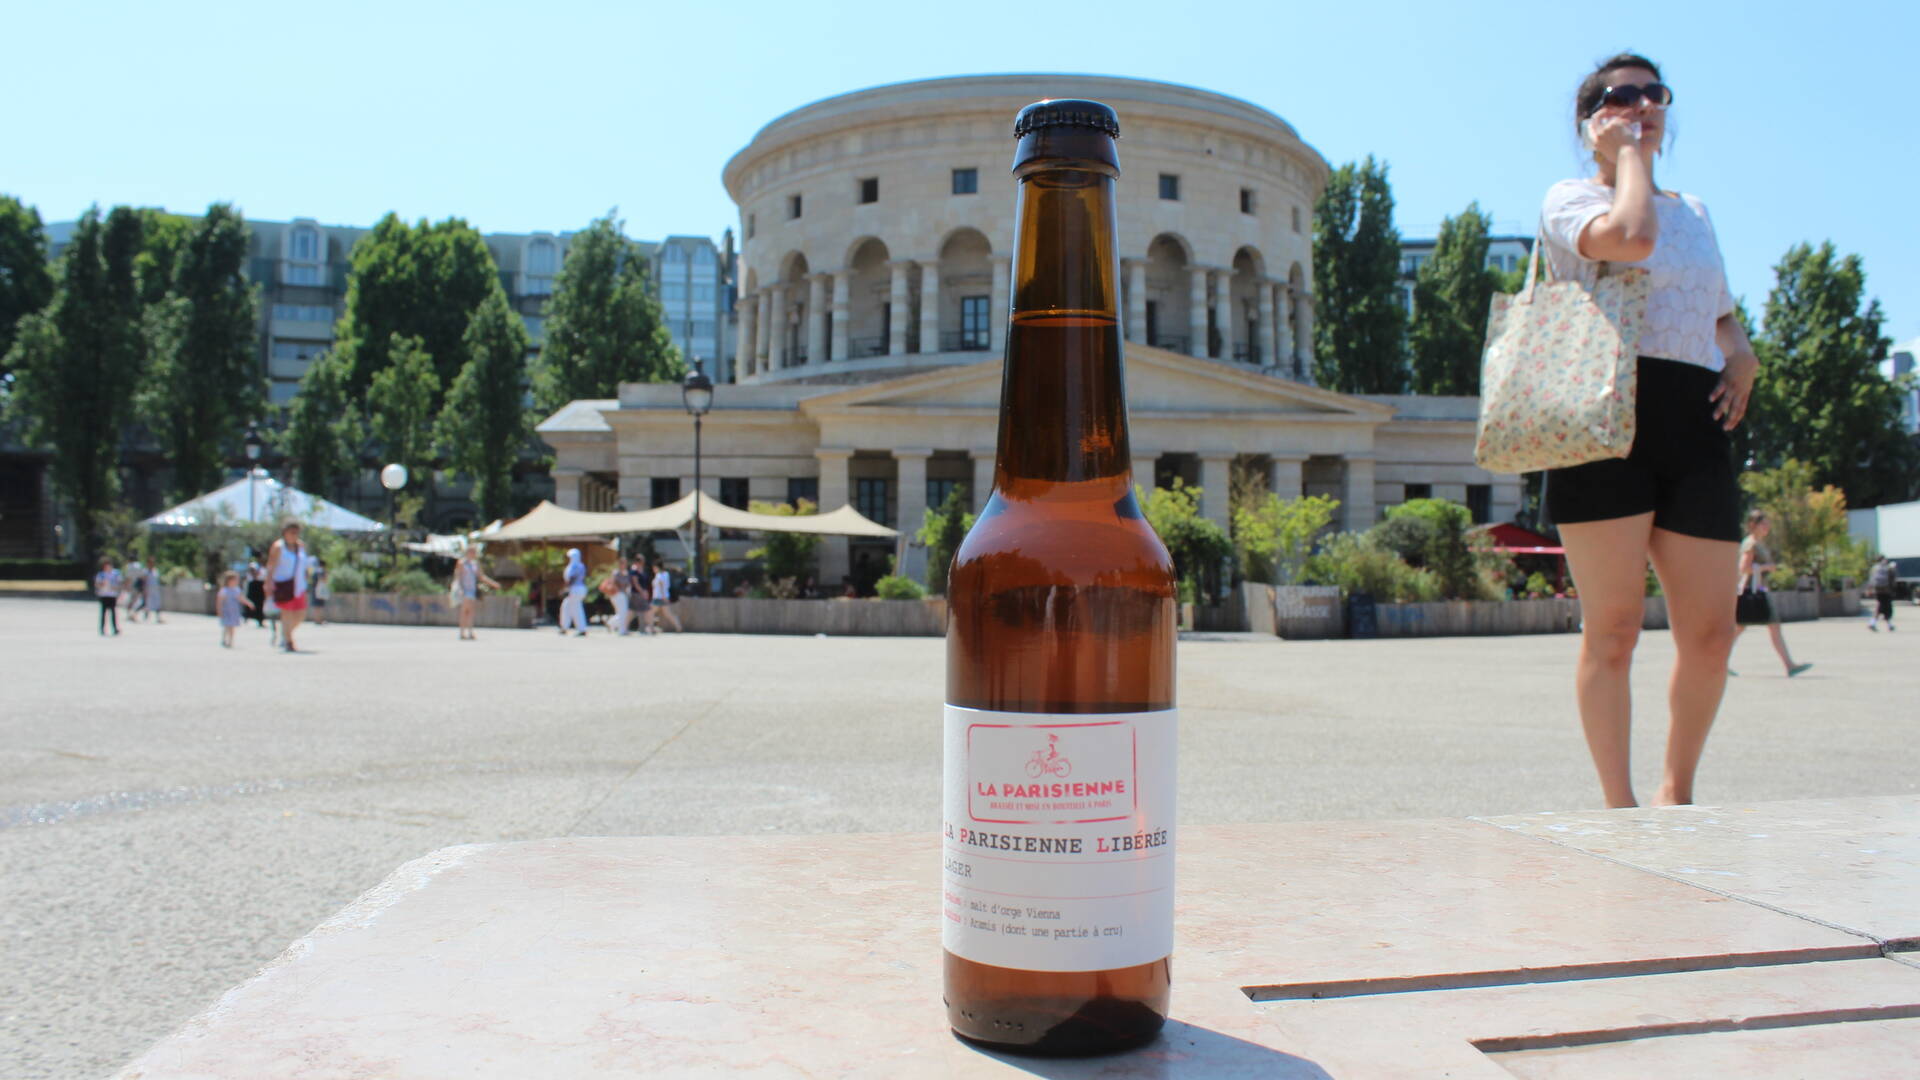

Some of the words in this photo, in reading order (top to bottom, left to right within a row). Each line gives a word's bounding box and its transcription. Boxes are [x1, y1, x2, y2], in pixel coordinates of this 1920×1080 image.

[977, 782, 997, 797] LA
[1003, 779, 1126, 798] PARISIENNE
[960, 828, 1082, 853] PARISIENNE
[1096, 826, 1168, 853] LIBÉRÉE
[944, 856, 972, 878] LAGER
[970, 901, 987, 913] malt
[991, 903, 1023, 919] d'orge
[1026, 908, 1061, 919] Vienna
[1001, 924, 1027, 937] (dont
[1032, 927, 1049, 937] une
[1054, 925, 1089, 940] partie
